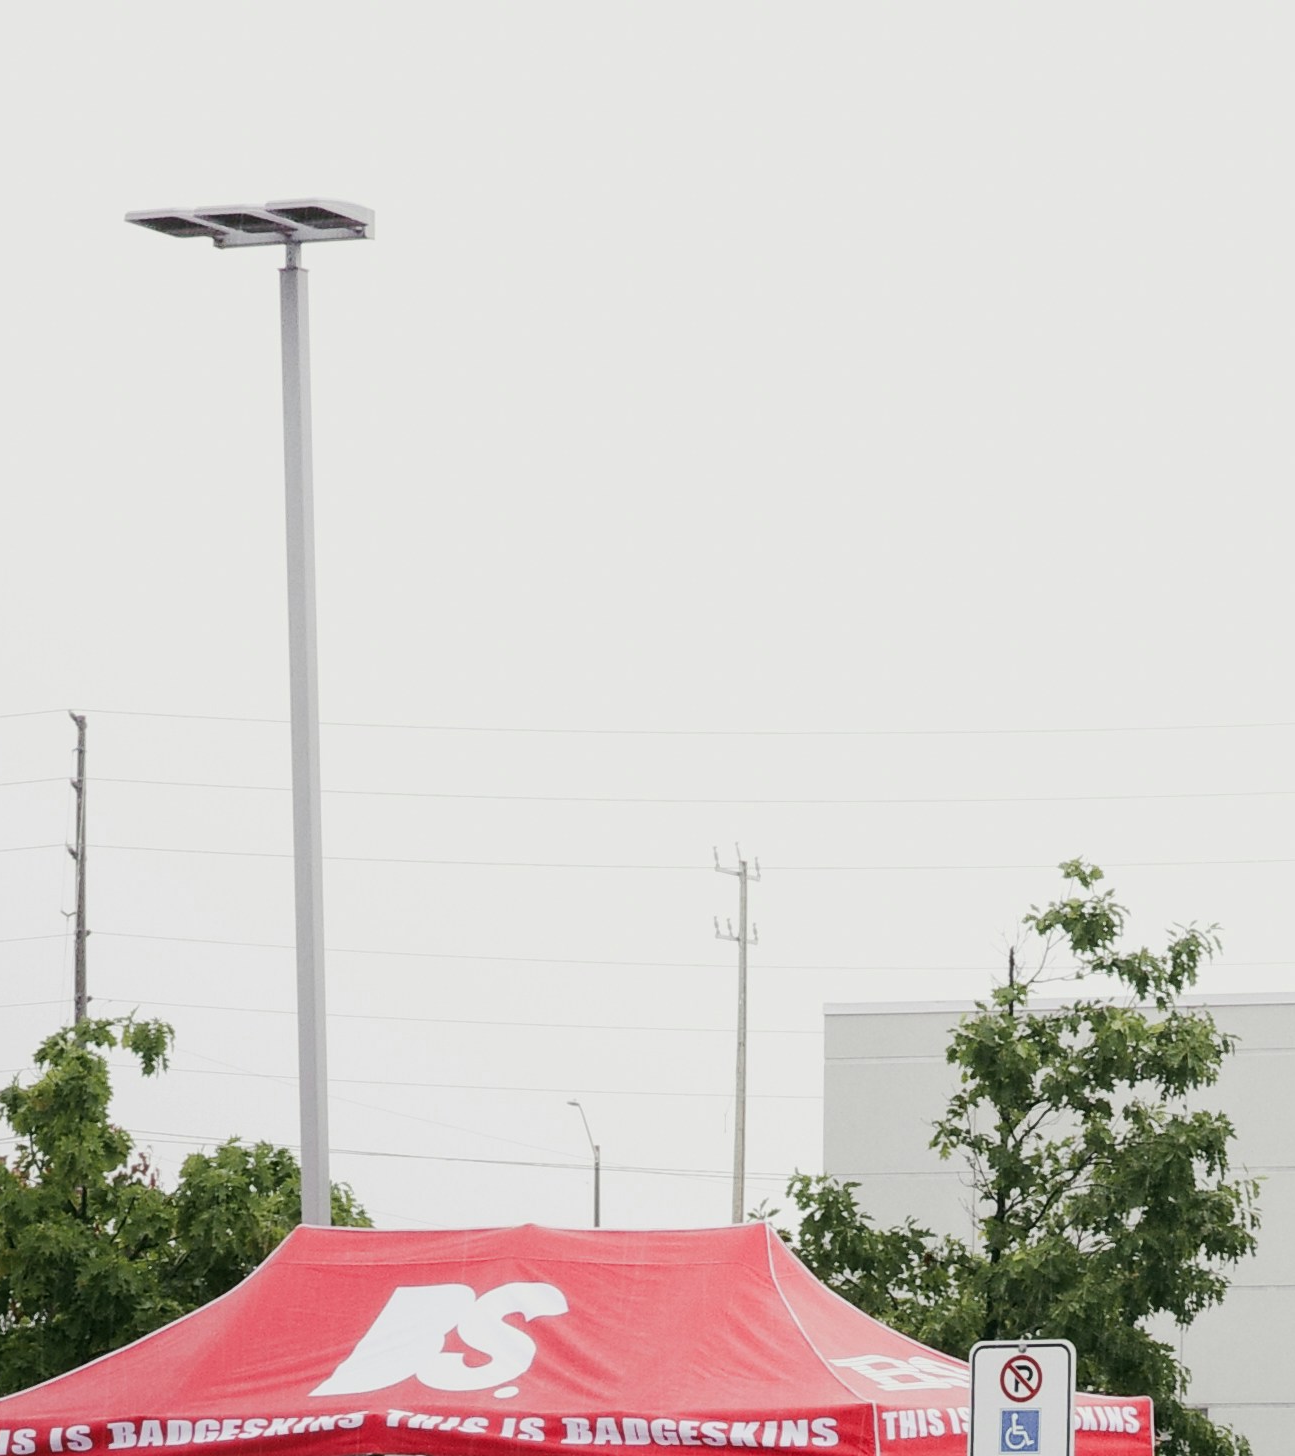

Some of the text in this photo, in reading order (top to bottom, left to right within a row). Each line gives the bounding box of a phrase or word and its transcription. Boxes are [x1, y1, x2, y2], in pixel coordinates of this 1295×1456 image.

[49, 1425, 93, 1452] IS
[108, 1411, 367, 1450] BADGESKINS
[386, 1409, 839, 1448] THIS IS BADGESKINS
[882, 1409, 945, 1441] THIS
